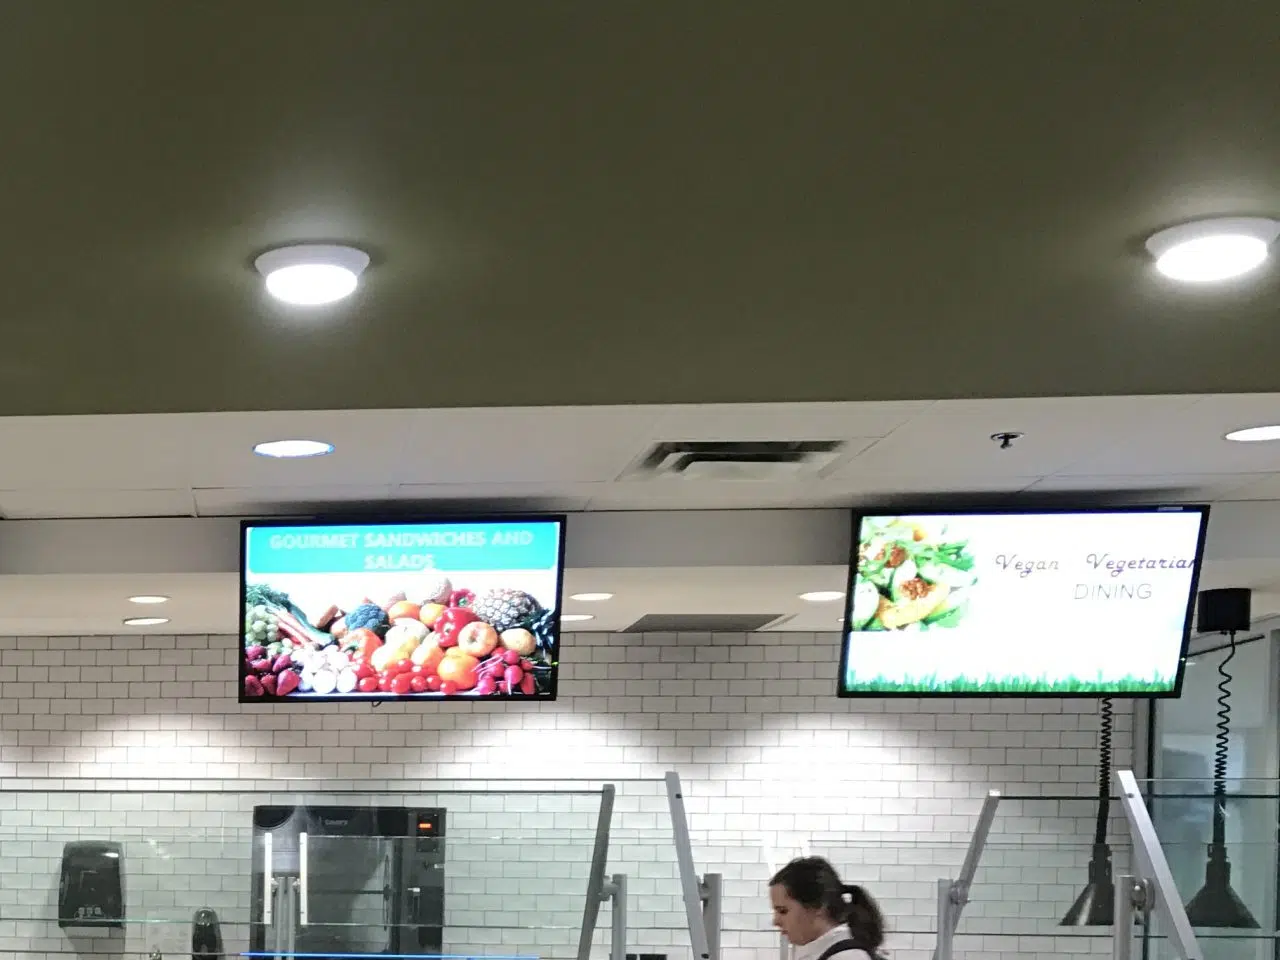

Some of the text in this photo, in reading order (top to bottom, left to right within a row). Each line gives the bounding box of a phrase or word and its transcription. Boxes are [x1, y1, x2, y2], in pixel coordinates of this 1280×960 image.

[269, 530, 534, 549] GOURMET SANDWICHES AND
[363, 554, 434, 570] SALADS
[995, 554, 1060, 578] Vegan
[1074, 583, 1153, 600] DINING
